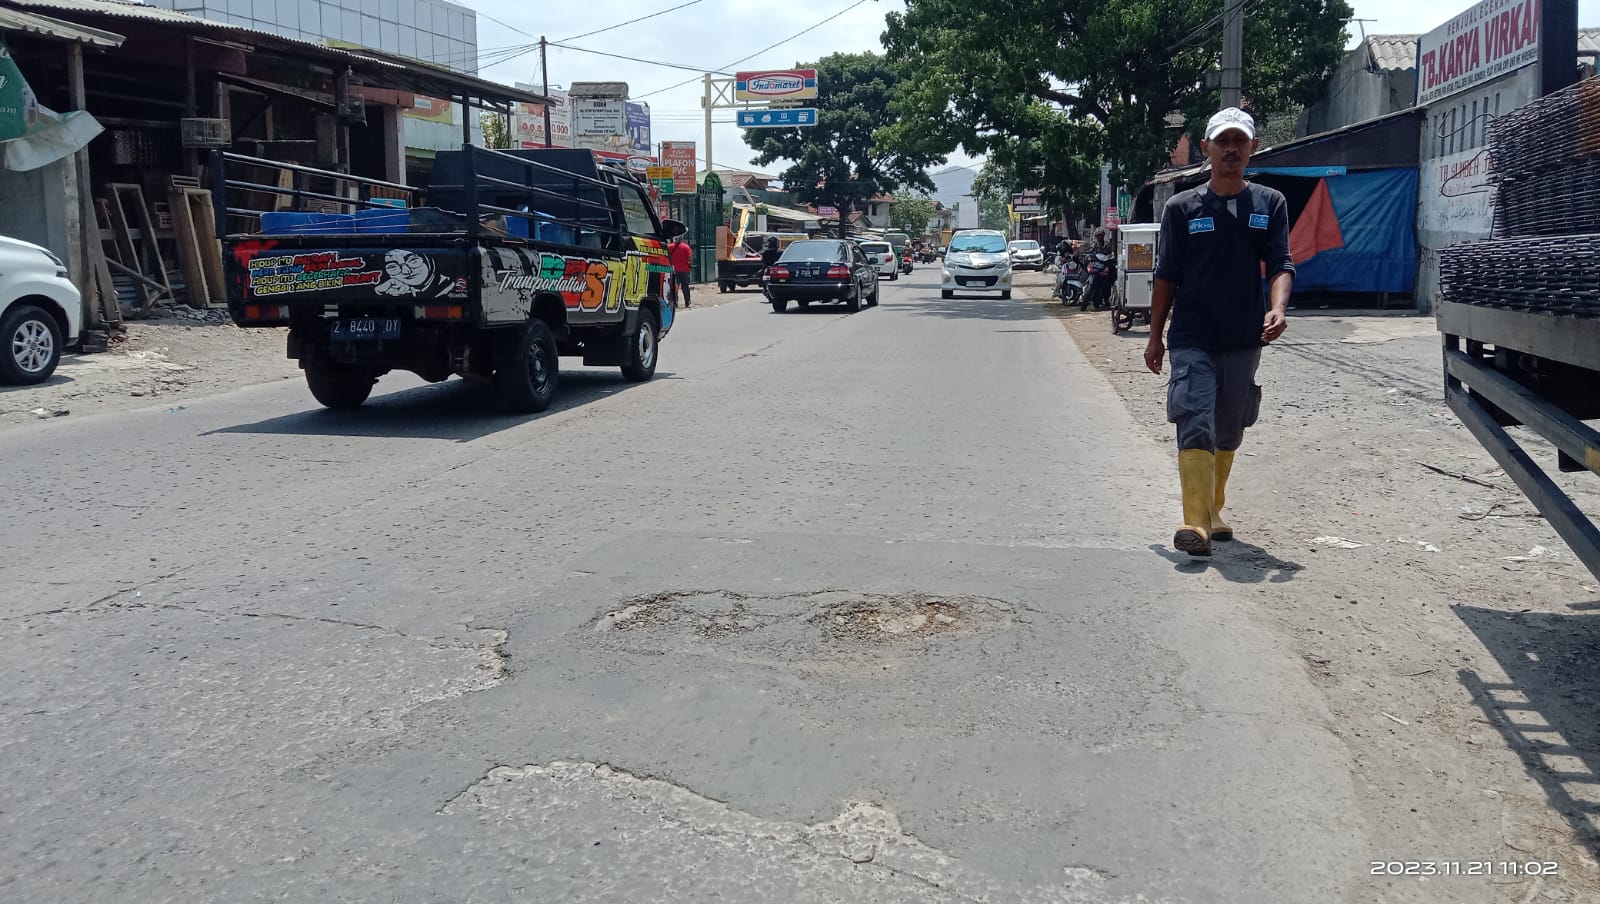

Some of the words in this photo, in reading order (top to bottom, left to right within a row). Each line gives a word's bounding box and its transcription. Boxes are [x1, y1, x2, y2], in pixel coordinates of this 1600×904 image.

[751, 79, 801, 90] Indomaret
[250, 257, 277, 269] HIDUP
[278, 256, 292, 266] ITU
[276, 265, 303, 274] YANG
[252, 275, 279, 286] HIDUP
[280, 274, 294, 284] ITU
[295, 269, 351, 281] SEDERHANA
[497, 269, 587, 292] Transportation
[256, 284, 289, 294] GENGSI
[290, 281, 316, 291] YANG
[318, 278, 342, 288] BIKIN
[334, 322, 340, 333] Z
[350, 320, 375, 333] 8440
[385, 319, 398, 332] DY
